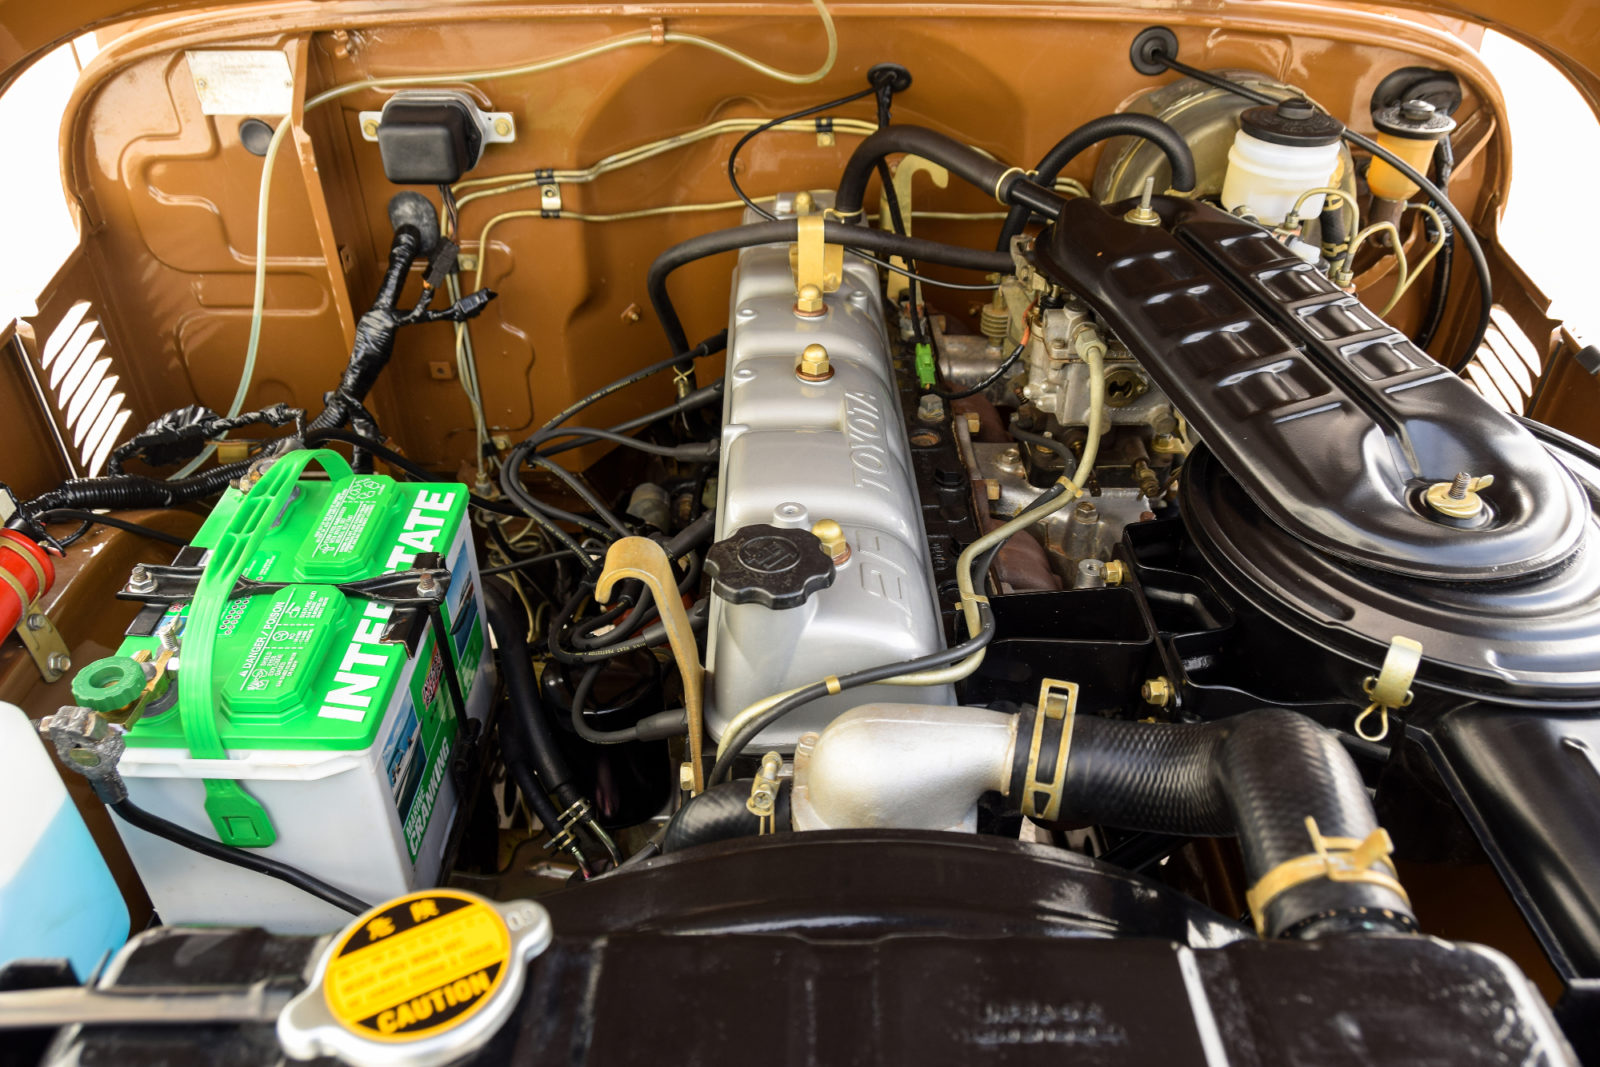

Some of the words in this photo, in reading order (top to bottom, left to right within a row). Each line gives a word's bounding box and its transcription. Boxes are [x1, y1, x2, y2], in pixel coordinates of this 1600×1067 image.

[844, 391, 892, 493] TOYOTA
[242, 637, 266, 669] DANGER
[263, 601, 285, 630] POISON
[405, 784, 425, 839] MARINE
[409, 736, 450, 856] CRANKING
[376, 970, 491, 1033] CAUTION
